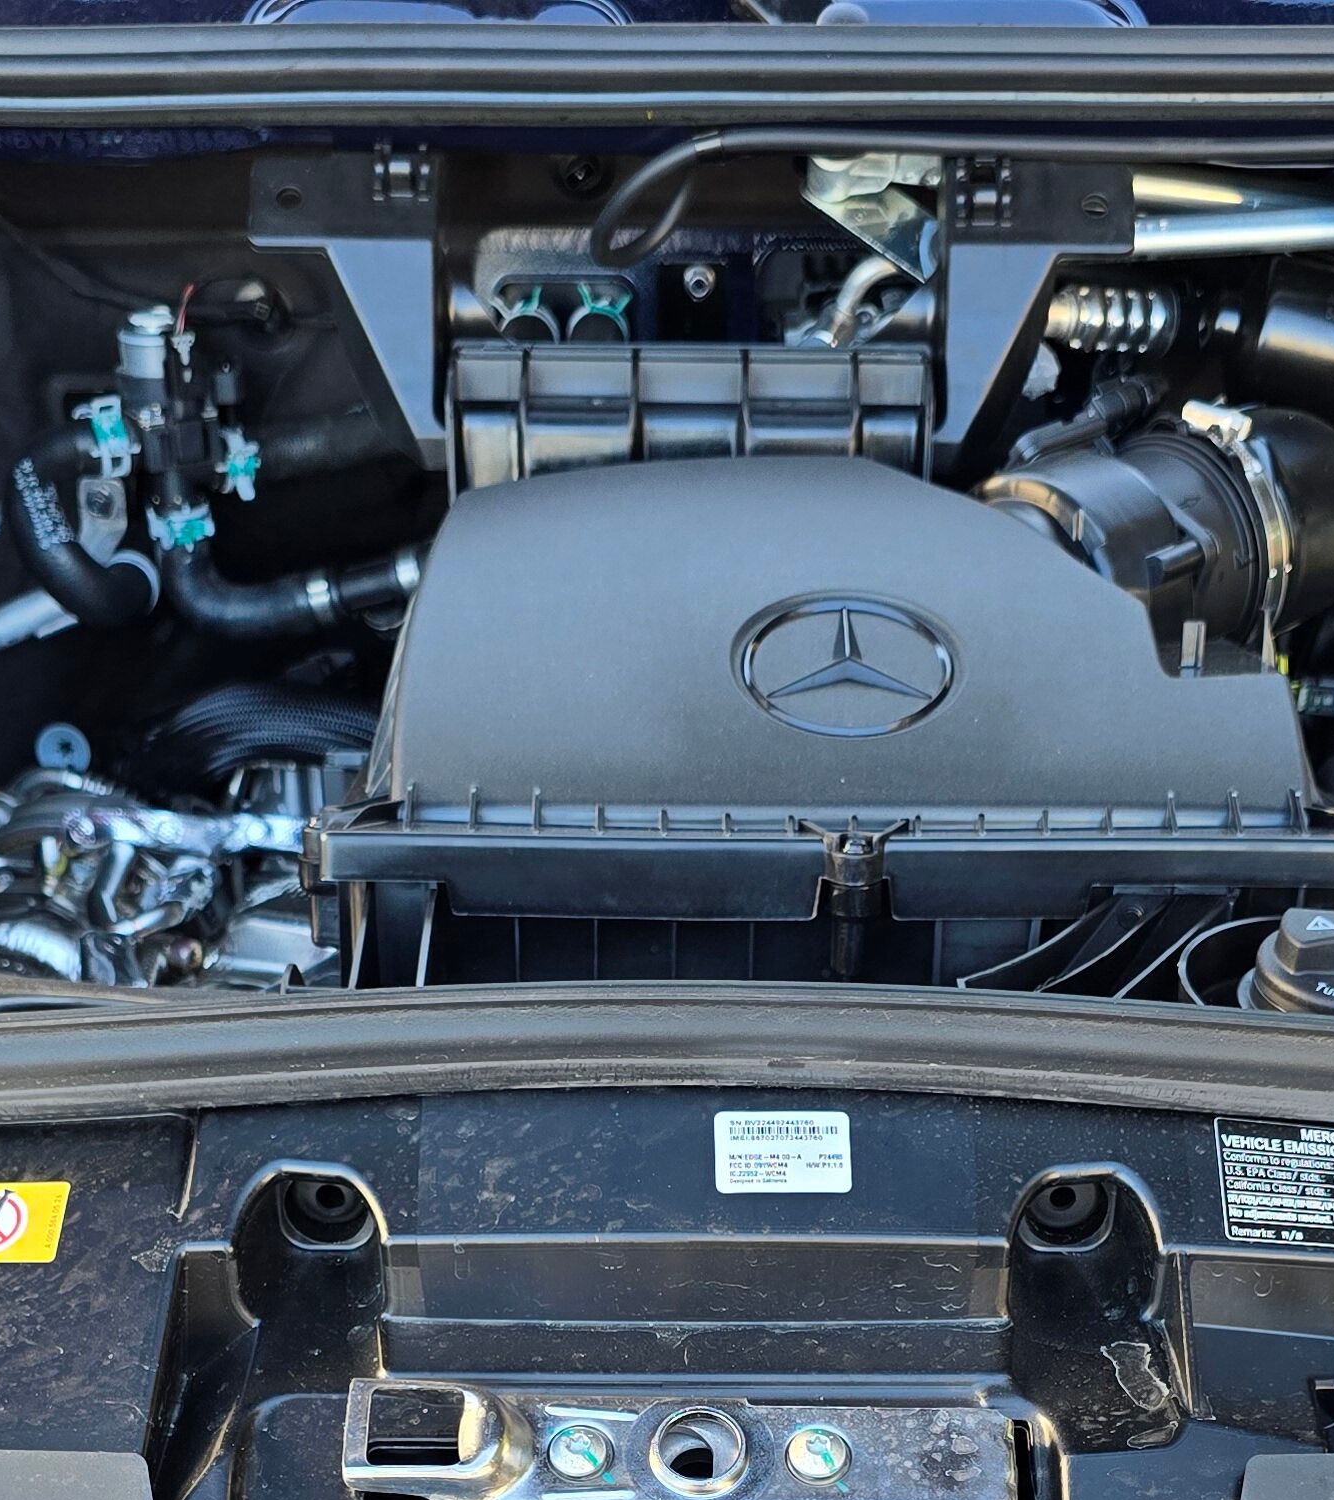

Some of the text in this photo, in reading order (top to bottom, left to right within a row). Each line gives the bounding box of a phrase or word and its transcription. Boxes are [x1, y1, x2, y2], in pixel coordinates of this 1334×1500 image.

[1221, 1133, 1282, 1151] VEHICLE
[1222, 1151, 1268, 1163] Conforms
[1269, 1155, 1279, 1165] to
[1225, 1165, 1244, 1175] U.S.
[1246, 1167, 1265, 1177] EPA
